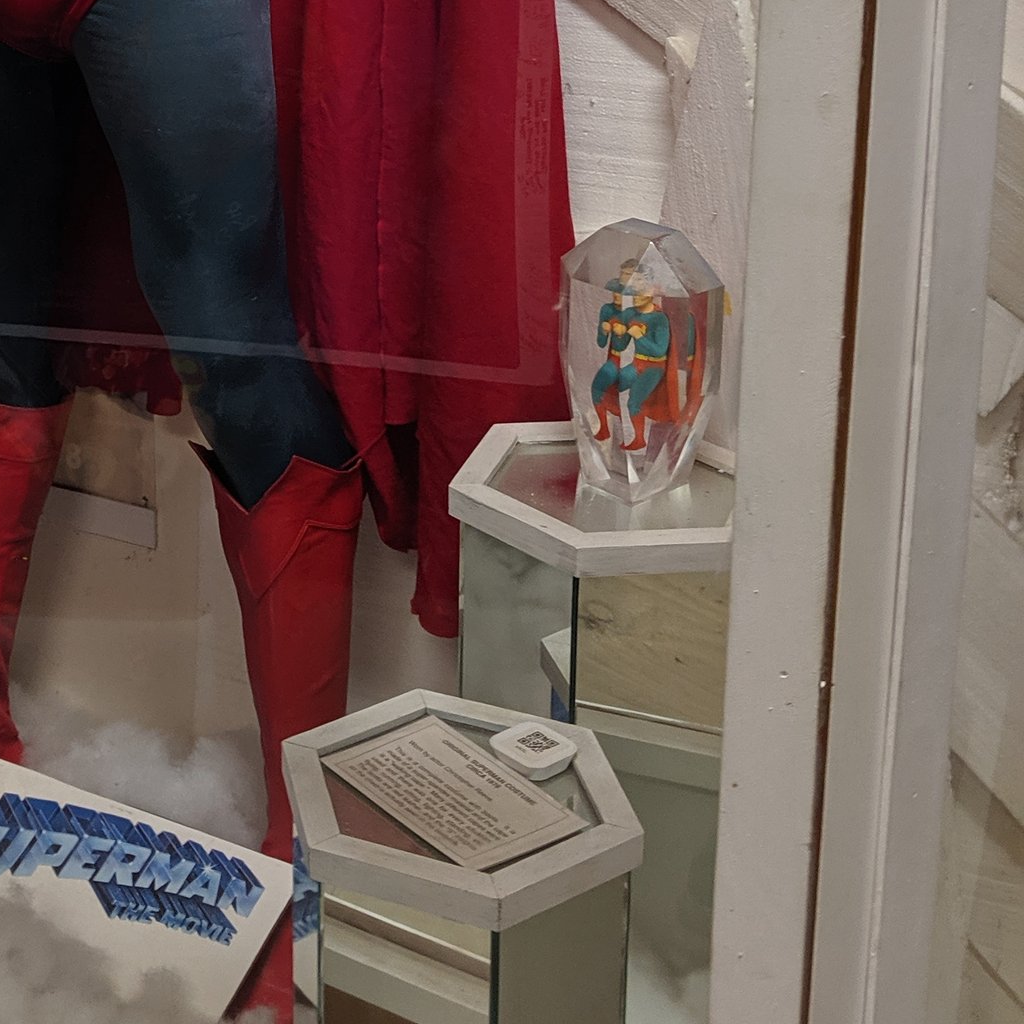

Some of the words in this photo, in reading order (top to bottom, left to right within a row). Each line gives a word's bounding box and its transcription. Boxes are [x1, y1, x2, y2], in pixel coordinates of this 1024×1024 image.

[393, 746, 408, 755] This
[441, 739, 472, 759] ORIGINAL
[470, 759, 507, 783] SUPERMAN
[503, 783, 538, 805] COSTUME
[442, 766, 475, 788] Christopher
[465, 764, 487, 778] CIRCA
[108, 897, 161, 925] THE
[159, 907, 239, 947] MOVIE
